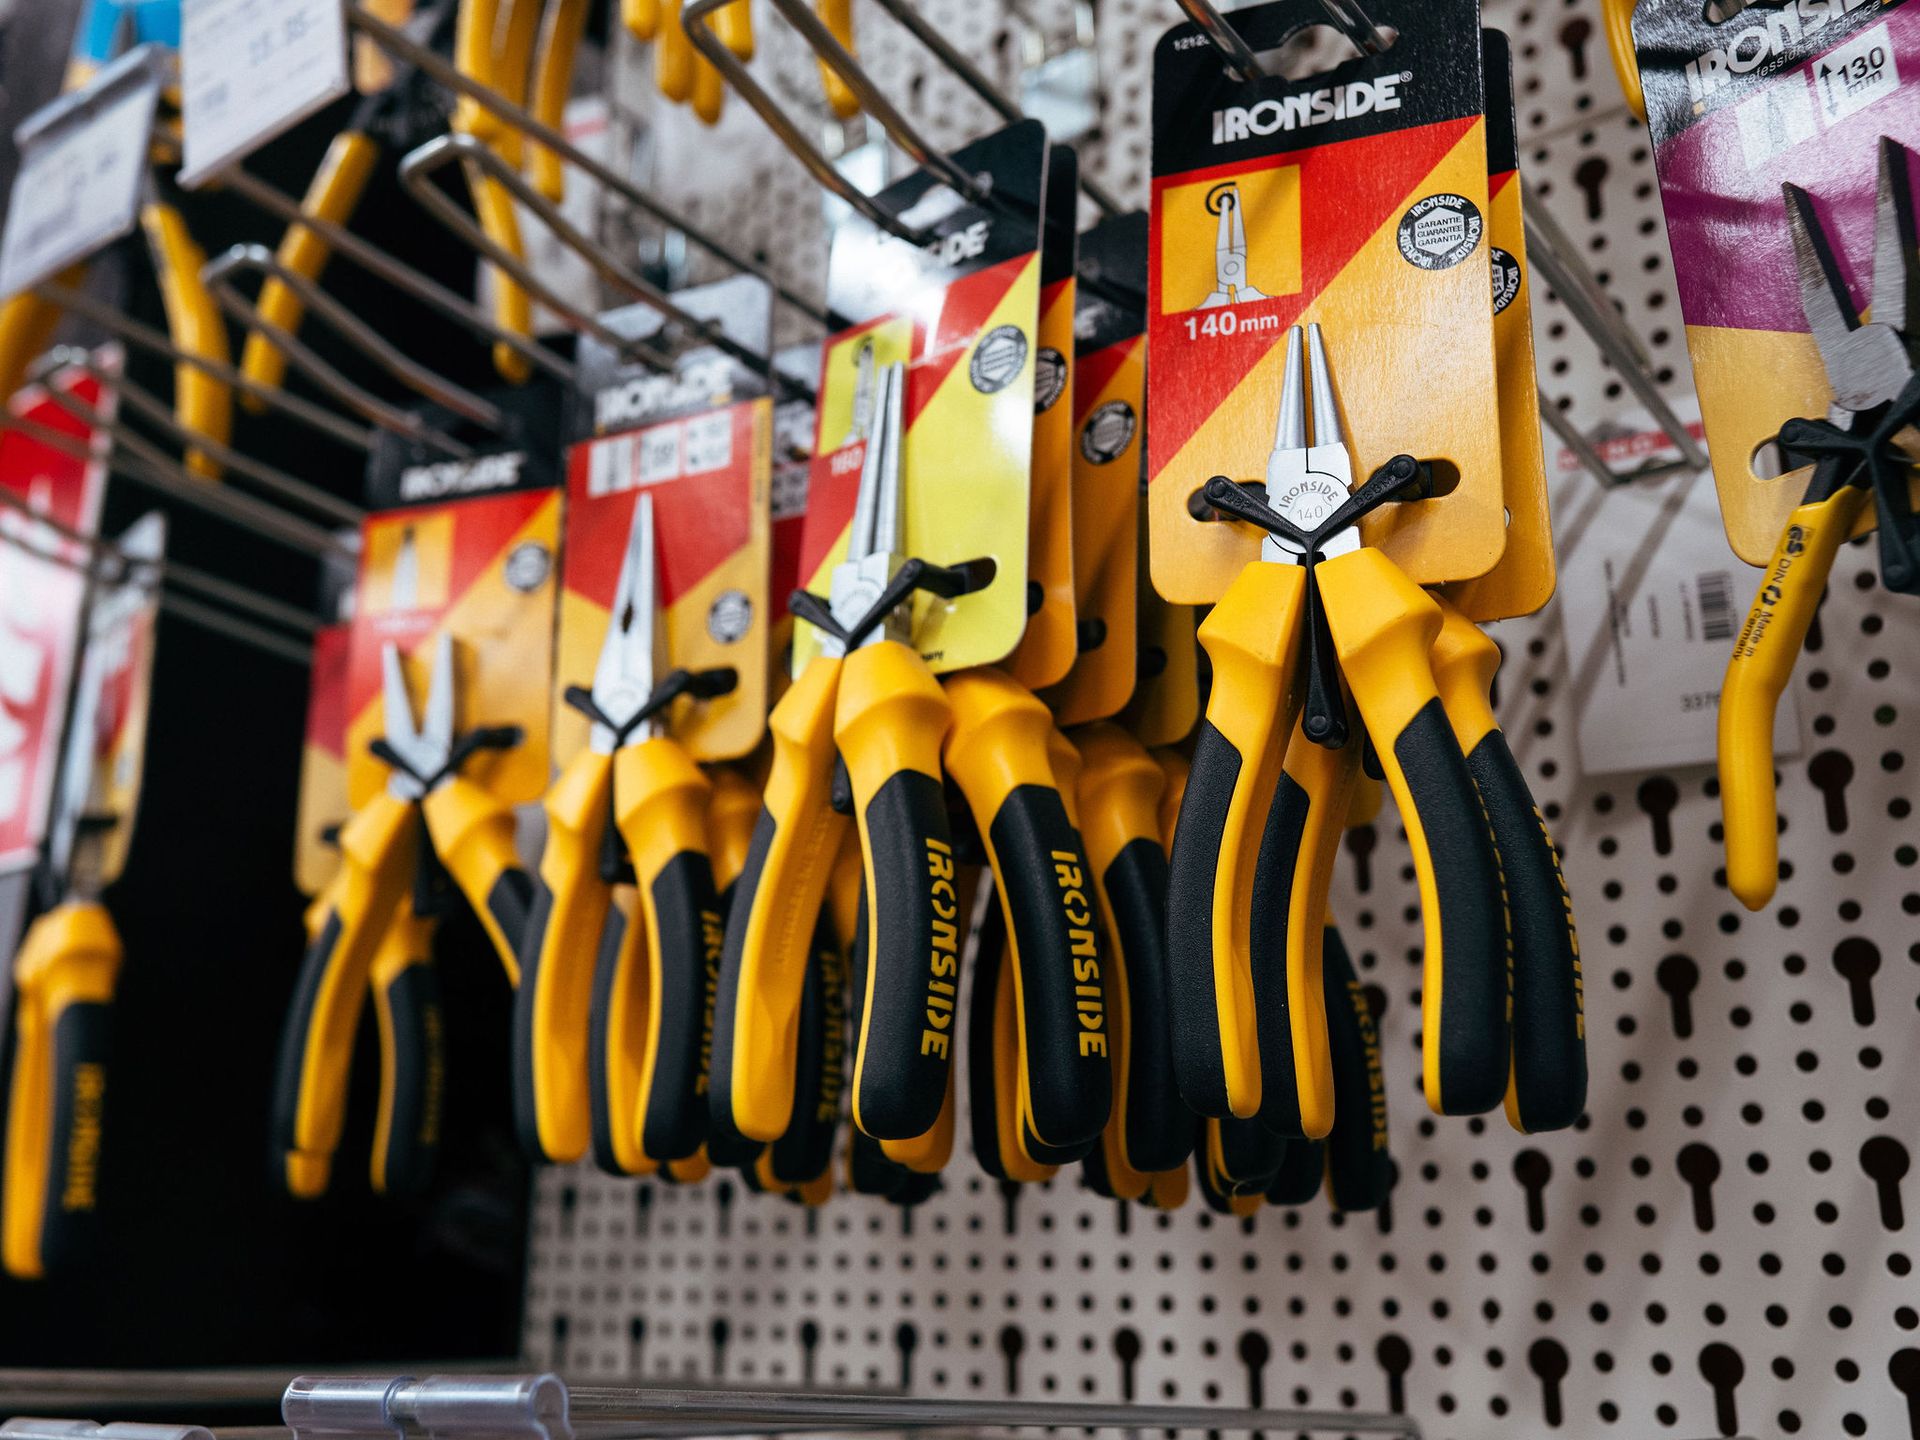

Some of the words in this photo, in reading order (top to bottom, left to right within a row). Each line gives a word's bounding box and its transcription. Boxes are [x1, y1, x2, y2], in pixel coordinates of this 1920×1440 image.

[1838, 46, 1885, 86] 130
[1846, 69, 1884, 98] mm
[1410, 195, 1467, 218] IRONSIDE
[1416, 216, 1462, 230] GARANTIE
[1417, 224, 1463, 239] GUARANTEE
[1417, 233, 1463, 247] GARANTIA
[1449, 215, 1481, 268] IRONSIDE
[1184, 311, 1237, 341] 140
[1240, 314, 1279, 333] mm
[1279, 480, 1340, 509] IRONSIDE
[1296, 504, 1325, 522] 140
[1772, 558, 1792, 584] DIN
[1732, 607, 1762, 662] Germany
[1753, 611, 1774, 644] Made
[1744, 645, 1756, 658] in
[921, 837, 957, 1060] IRONSIDE
[1051, 850, 1107, 1058] IRONSIDE
